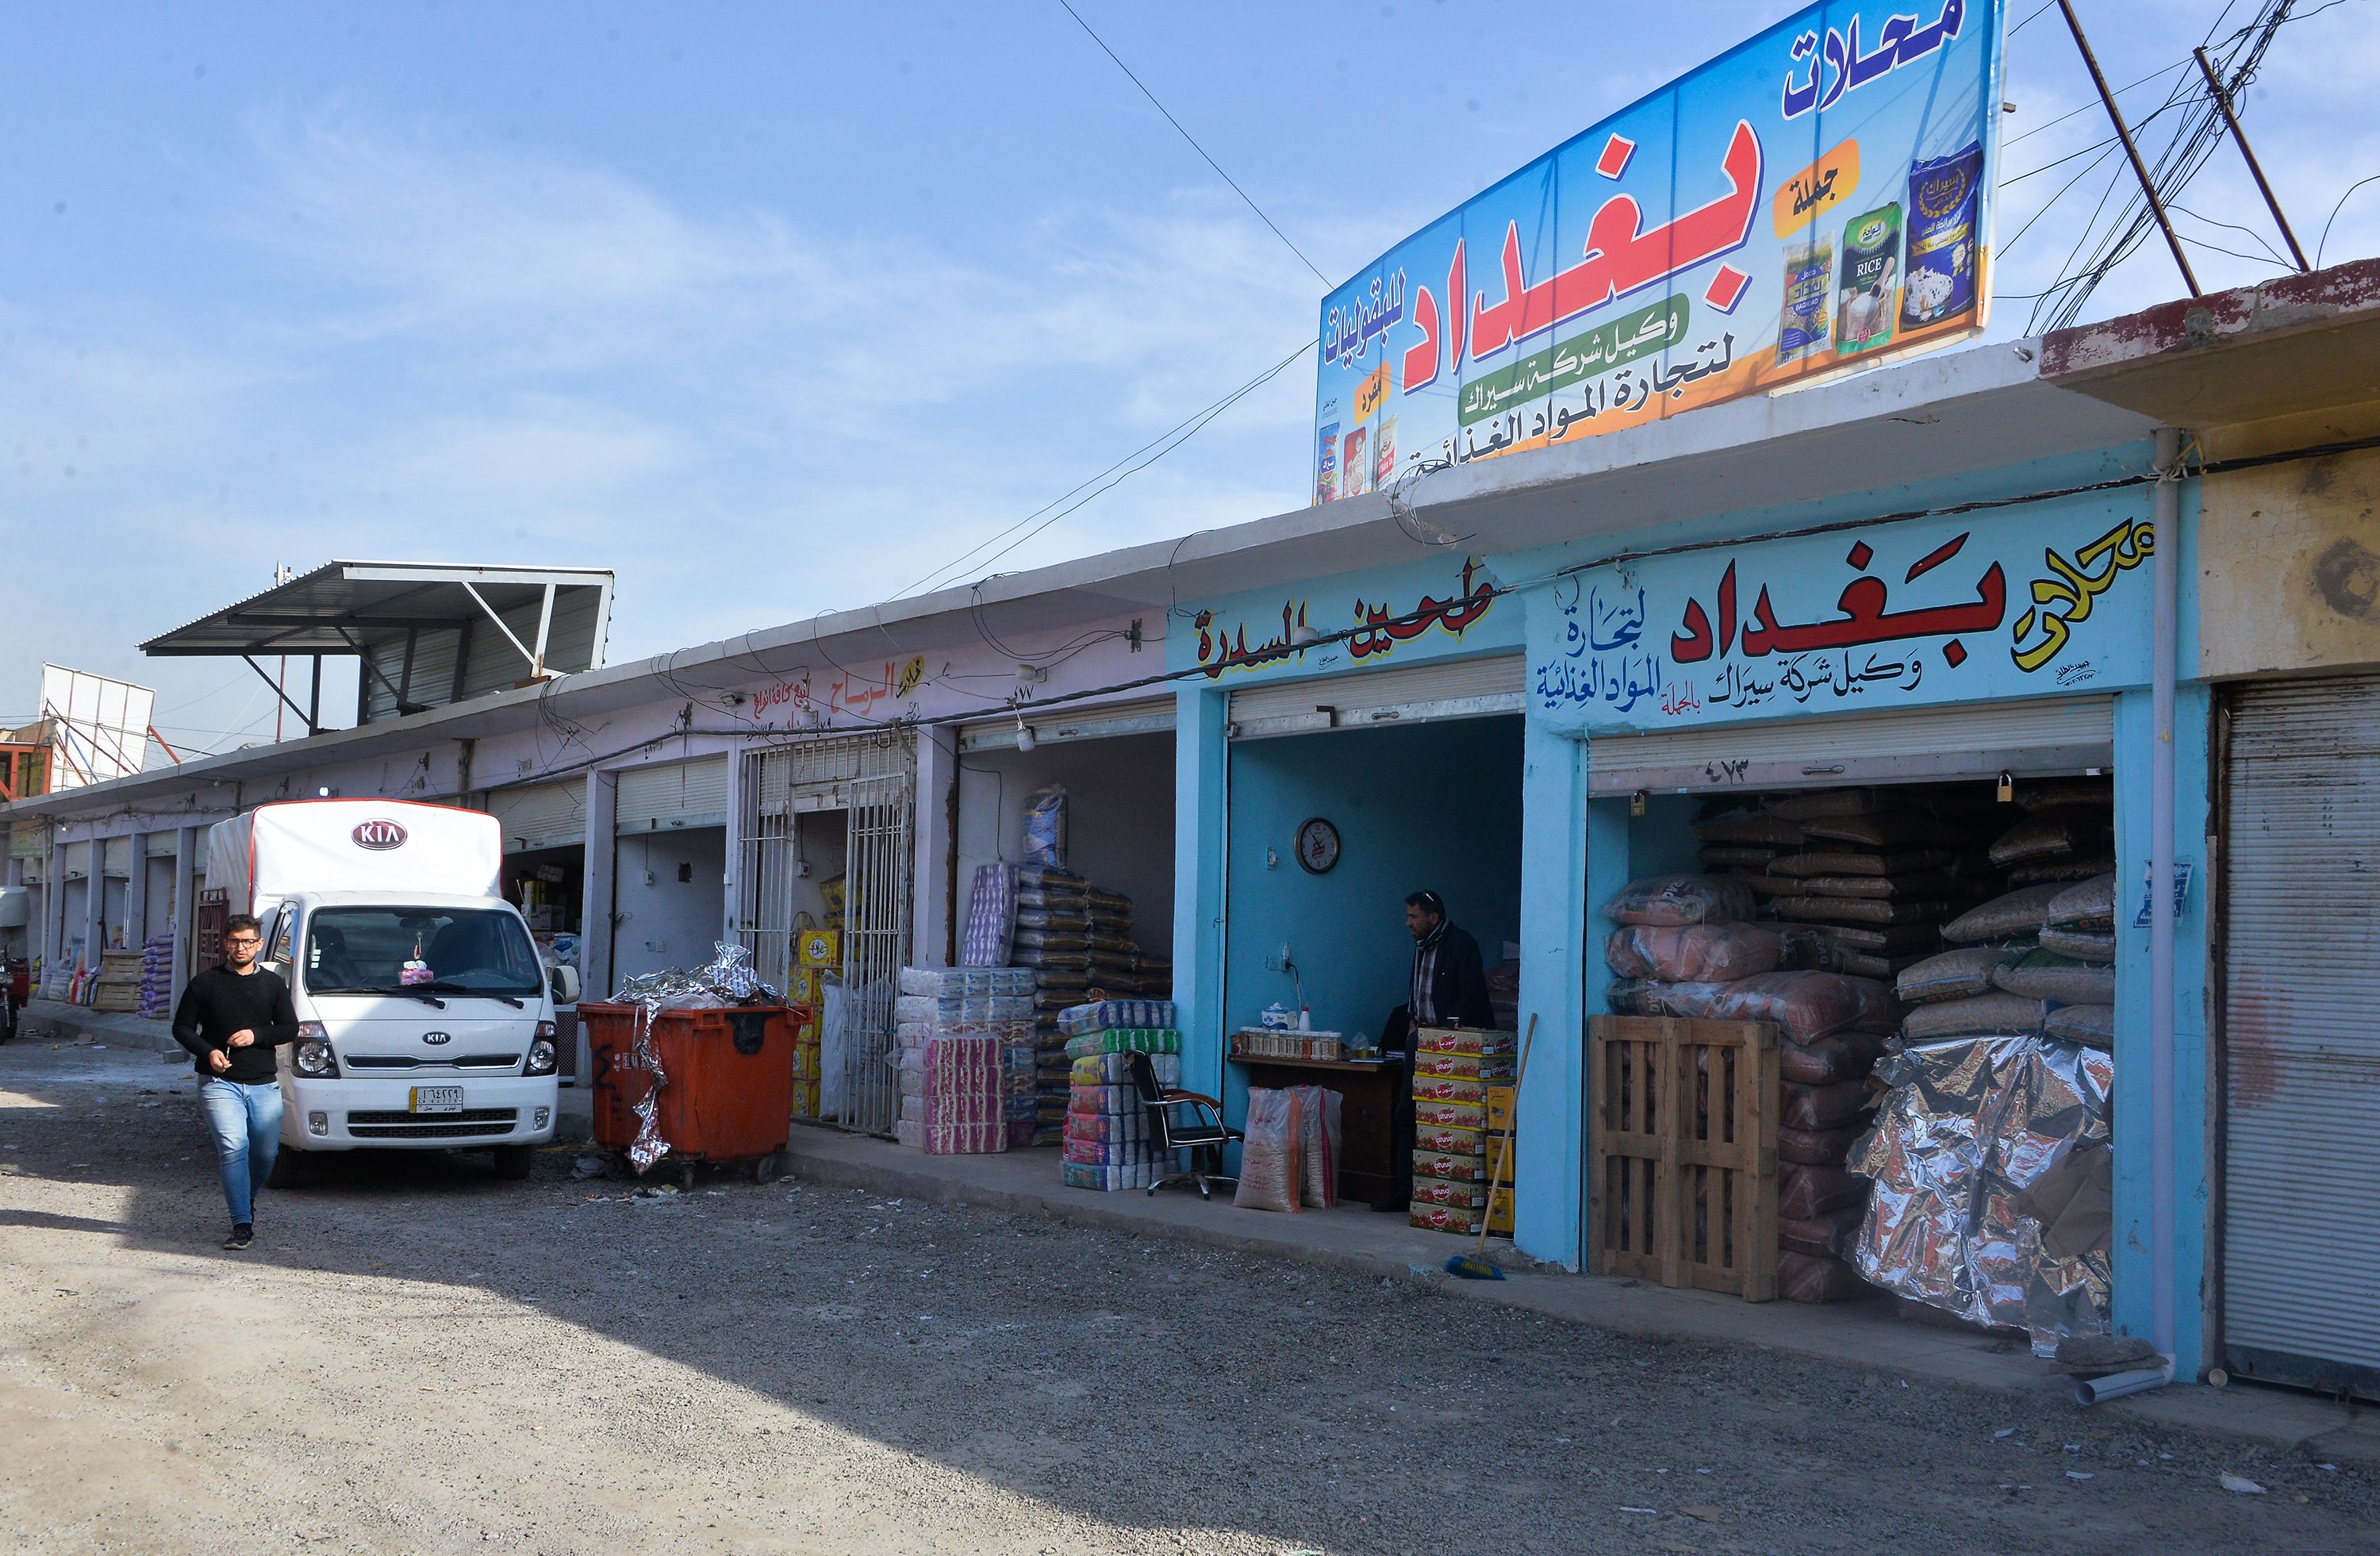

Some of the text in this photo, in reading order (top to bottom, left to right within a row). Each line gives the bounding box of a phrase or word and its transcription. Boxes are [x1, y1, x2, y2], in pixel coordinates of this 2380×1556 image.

[1783, 0, 1965, 120] محلات
[1790, 167, 1838, 217] جملة
[1403, 117, 1763, 395] بغداد
[1856, 257, 1882, 277] RICE
[1324, 266, 1407, 370] للبقوليات
[1794, 280, 1822, 300] بغداد
[1795, 298, 1818, 311] BAGHDAD
[1464, 310, 1679, 413] وكيل شركة سيراك
[1613, 331, 1736, 412] لتجارة
[1361, 375, 1382, 413] مفرد
[1530, 377, 1606, 440] المواد
[1349, 555, 1497, 659] طحين
[1671, 531, 2006, 670] بغداد
[359, 824, 400, 843] KIA
[428, 1034, 447, 1043] KIA
